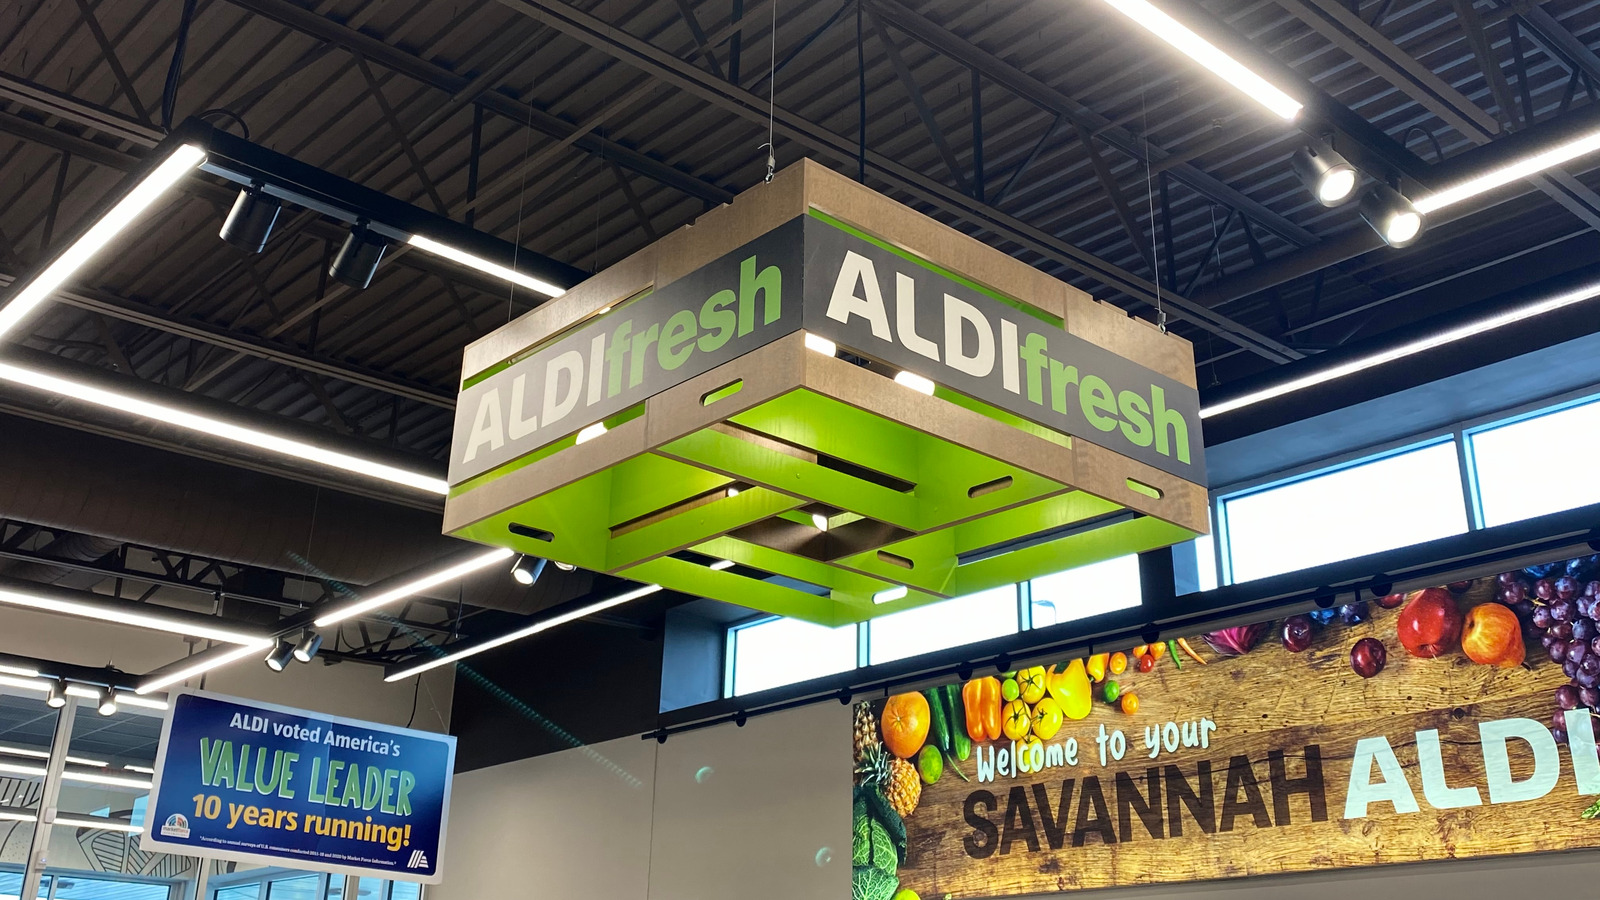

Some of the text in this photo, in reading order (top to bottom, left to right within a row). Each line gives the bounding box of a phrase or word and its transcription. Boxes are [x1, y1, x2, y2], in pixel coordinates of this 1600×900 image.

[229, 712, 401, 757] ALDI voted America's
[976, 718, 1217, 783] Welcome to your
[200, 737, 416, 816] VALUE LEADER
[963, 708, 1600, 859] SAVANNAH ALDI
[192, 793, 412, 852] 10 years running!
